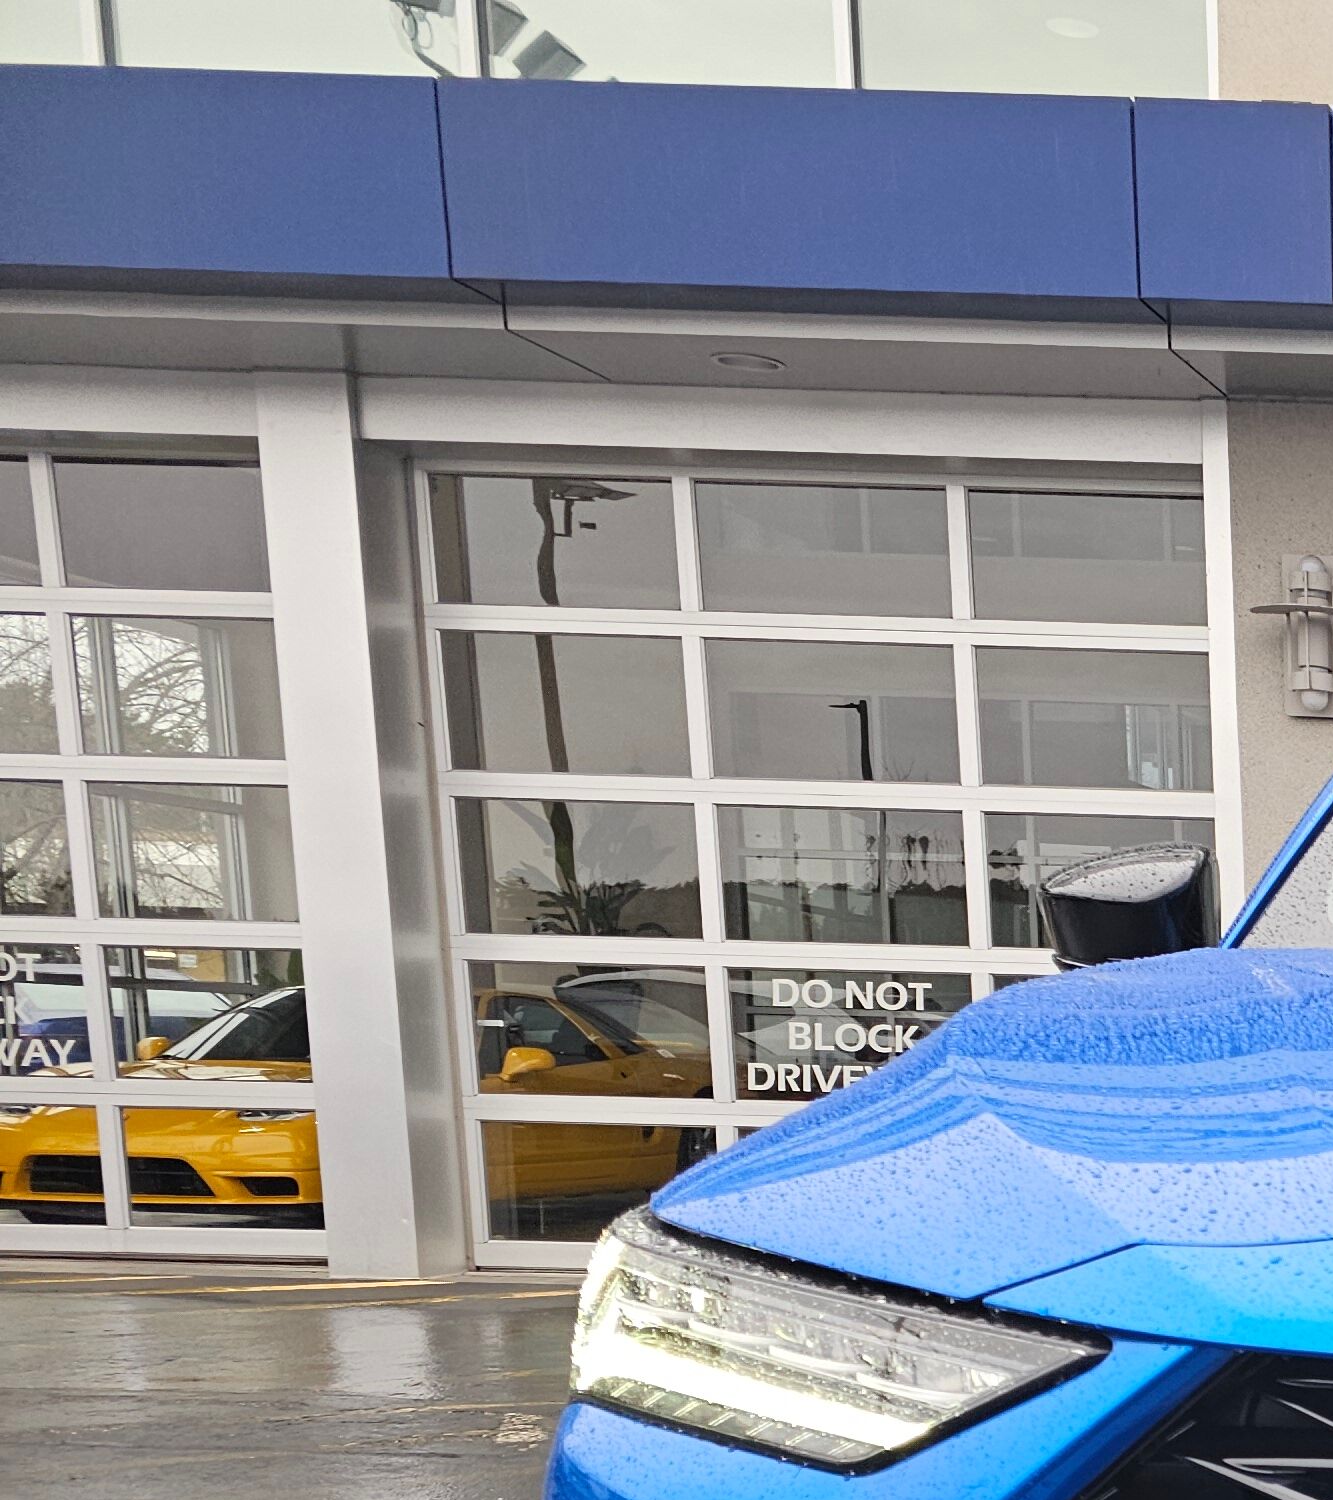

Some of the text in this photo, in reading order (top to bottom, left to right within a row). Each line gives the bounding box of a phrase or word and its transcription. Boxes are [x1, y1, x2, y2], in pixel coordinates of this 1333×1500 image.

[771, 978, 933, 1011] DO NOT
[788, 1021, 920, 1054] BLOCK
[747, 1062, 882, 1093] DRIVE
